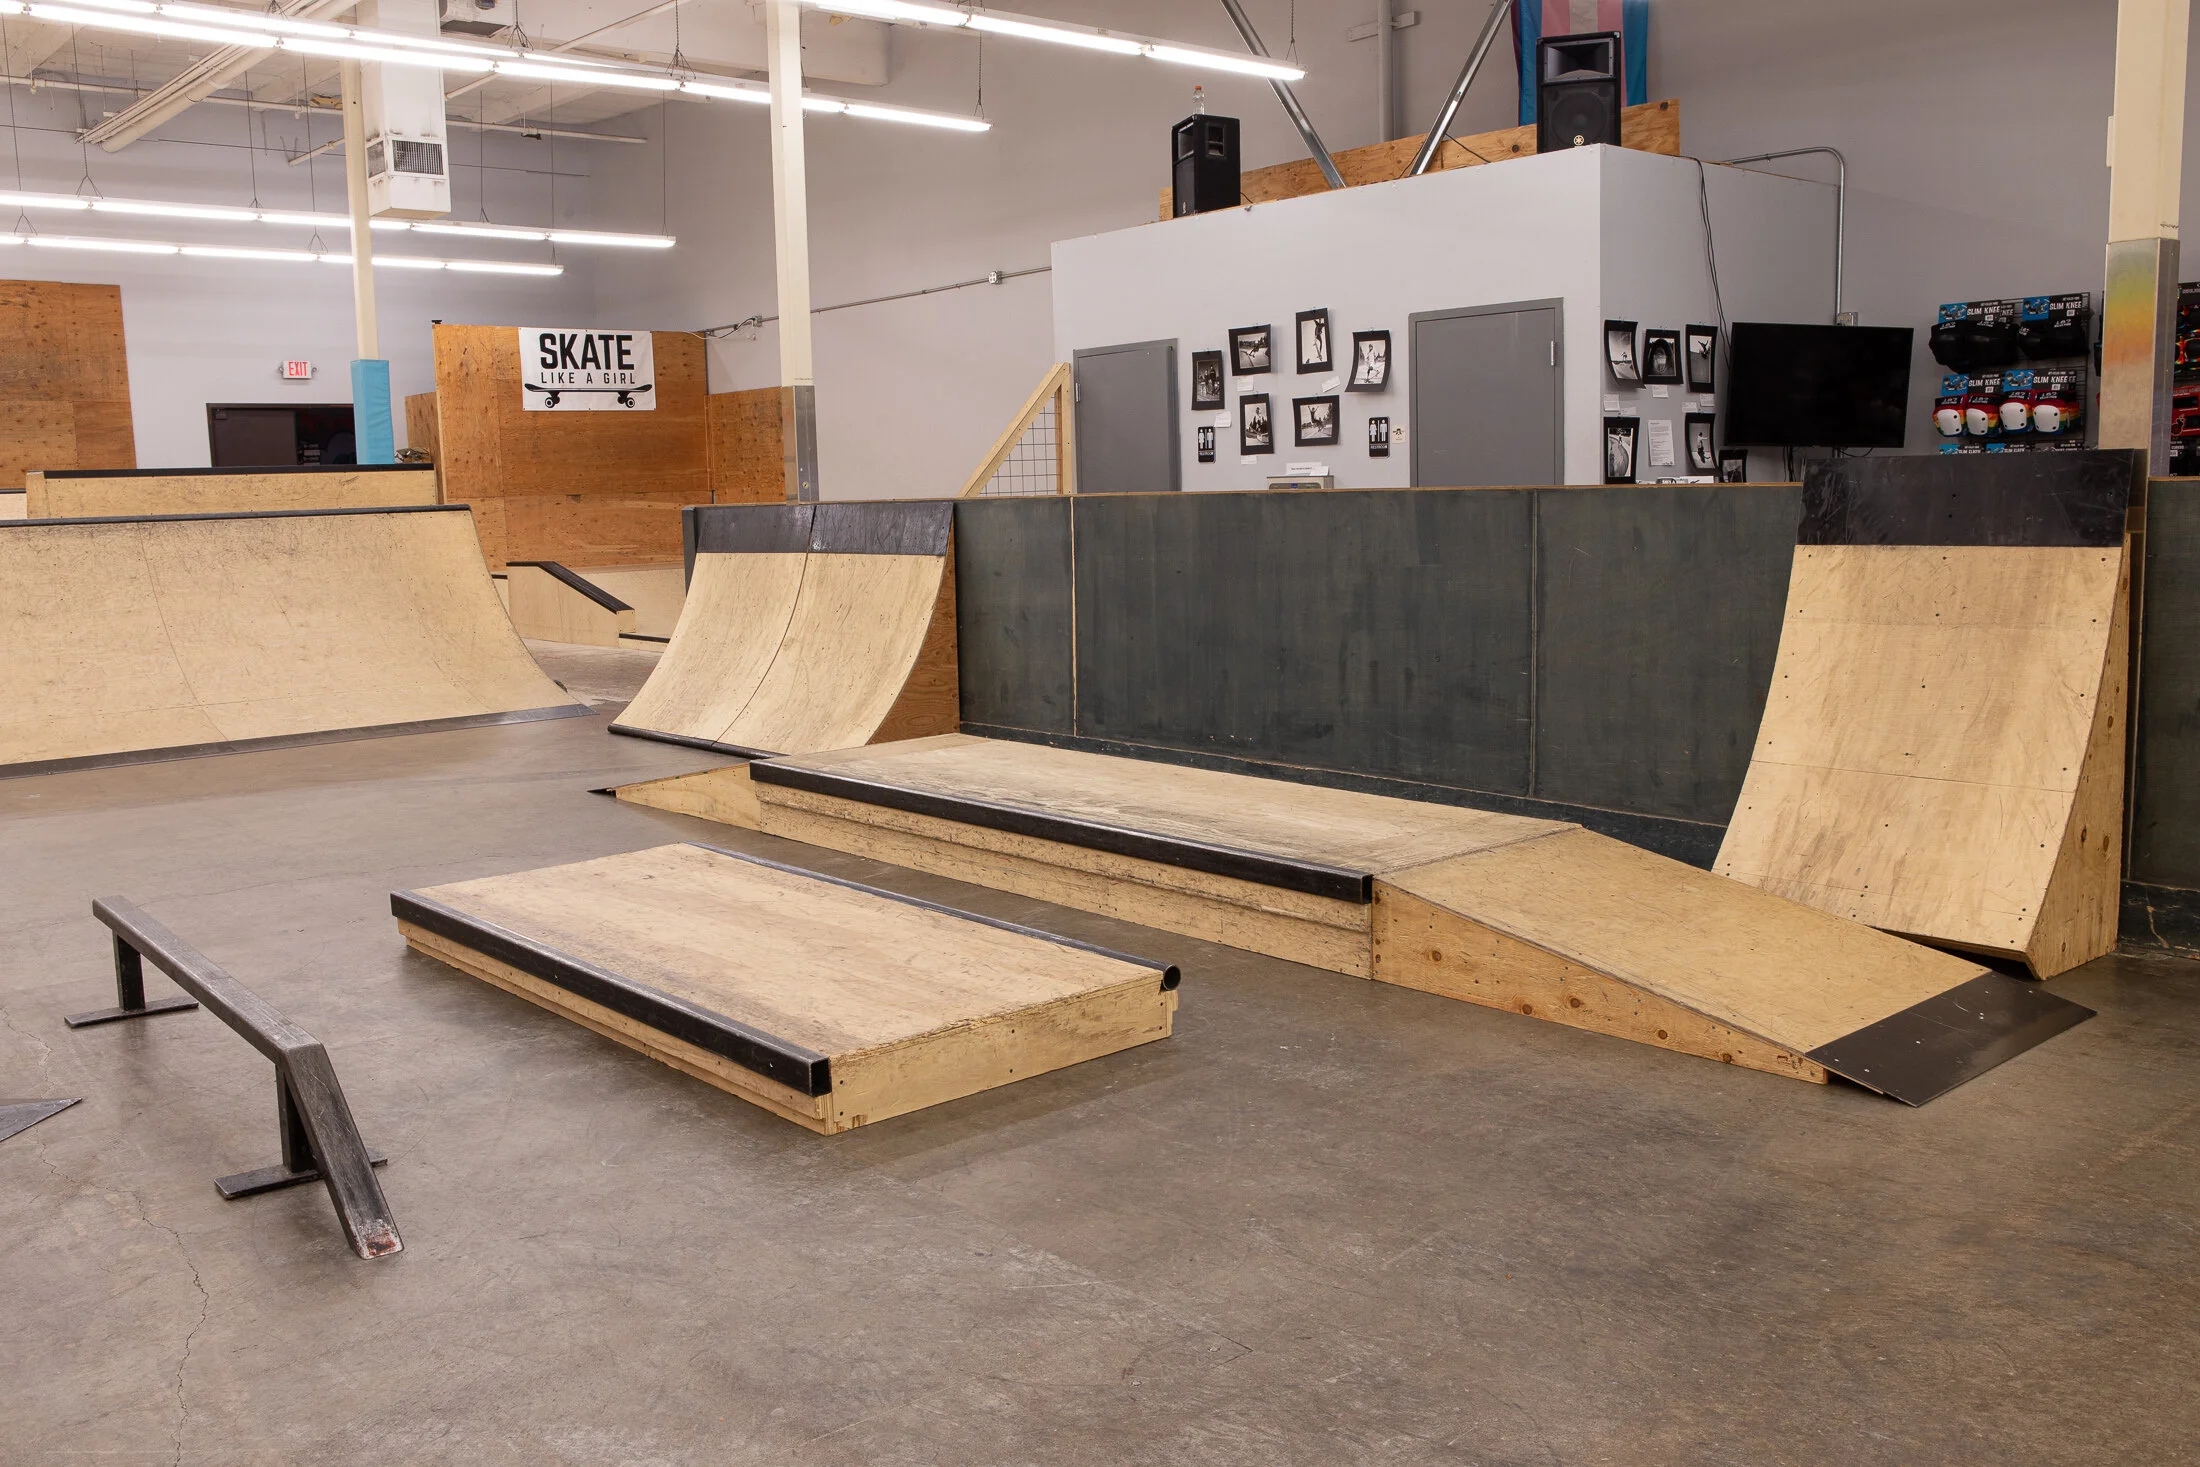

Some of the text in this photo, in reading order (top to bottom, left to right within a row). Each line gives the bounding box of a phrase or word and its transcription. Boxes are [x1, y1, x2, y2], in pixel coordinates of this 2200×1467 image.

[1966, 308, 1982, 316] SLIM
[1984, 306, 2001, 314] KNEE
[2049, 301, 2082, 311] SLIM KNEE
[539, 333, 635, 370] SKATE
[288, 361, 308, 377] EXIT
[541, 372, 636, 384] LIKE A GIRL
[1968, 378, 2001, 387] SLIM KNEE
[2033, 375, 2068, 384] SLIM KNEE
